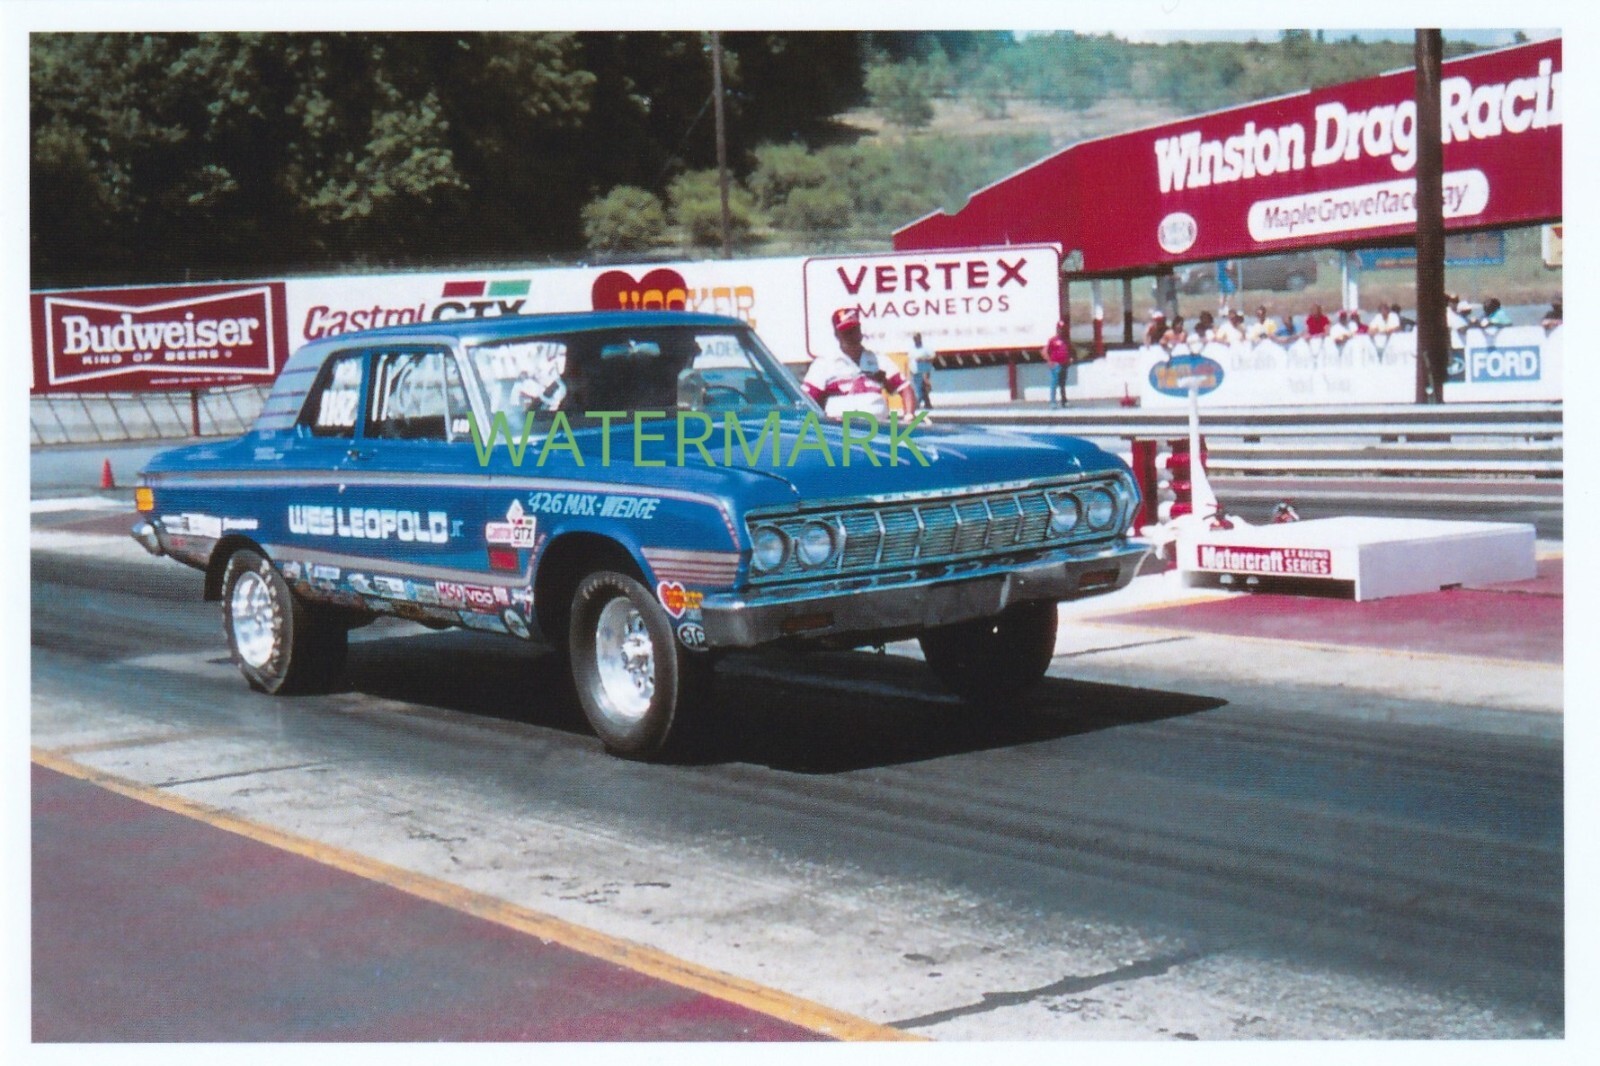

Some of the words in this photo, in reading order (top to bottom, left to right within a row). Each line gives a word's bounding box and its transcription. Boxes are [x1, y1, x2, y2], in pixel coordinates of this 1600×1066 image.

[1154, 121, 1306, 194] Winston
[1311, 100, 1417, 172] Drag
[837, 257, 1028, 295] VERTEX
[857, 295, 1010, 318] MAGNETOS
[61, 312, 259, 354] Budweiser
[82, 353, 122, 365] KING
[132, 351, 153, 363] OF
[164, 349, 219, 361] BEERS
[1472, 350, 1538, 378] FORD
[288, 505, 335, 536] WES
[336, 507, 448, 544] LEOPOLD
[1202, 547, 1284, 572] Motorcraft
[1285, 558, 1328, 574] SERIES
[682, 626, 705, 646] STP
